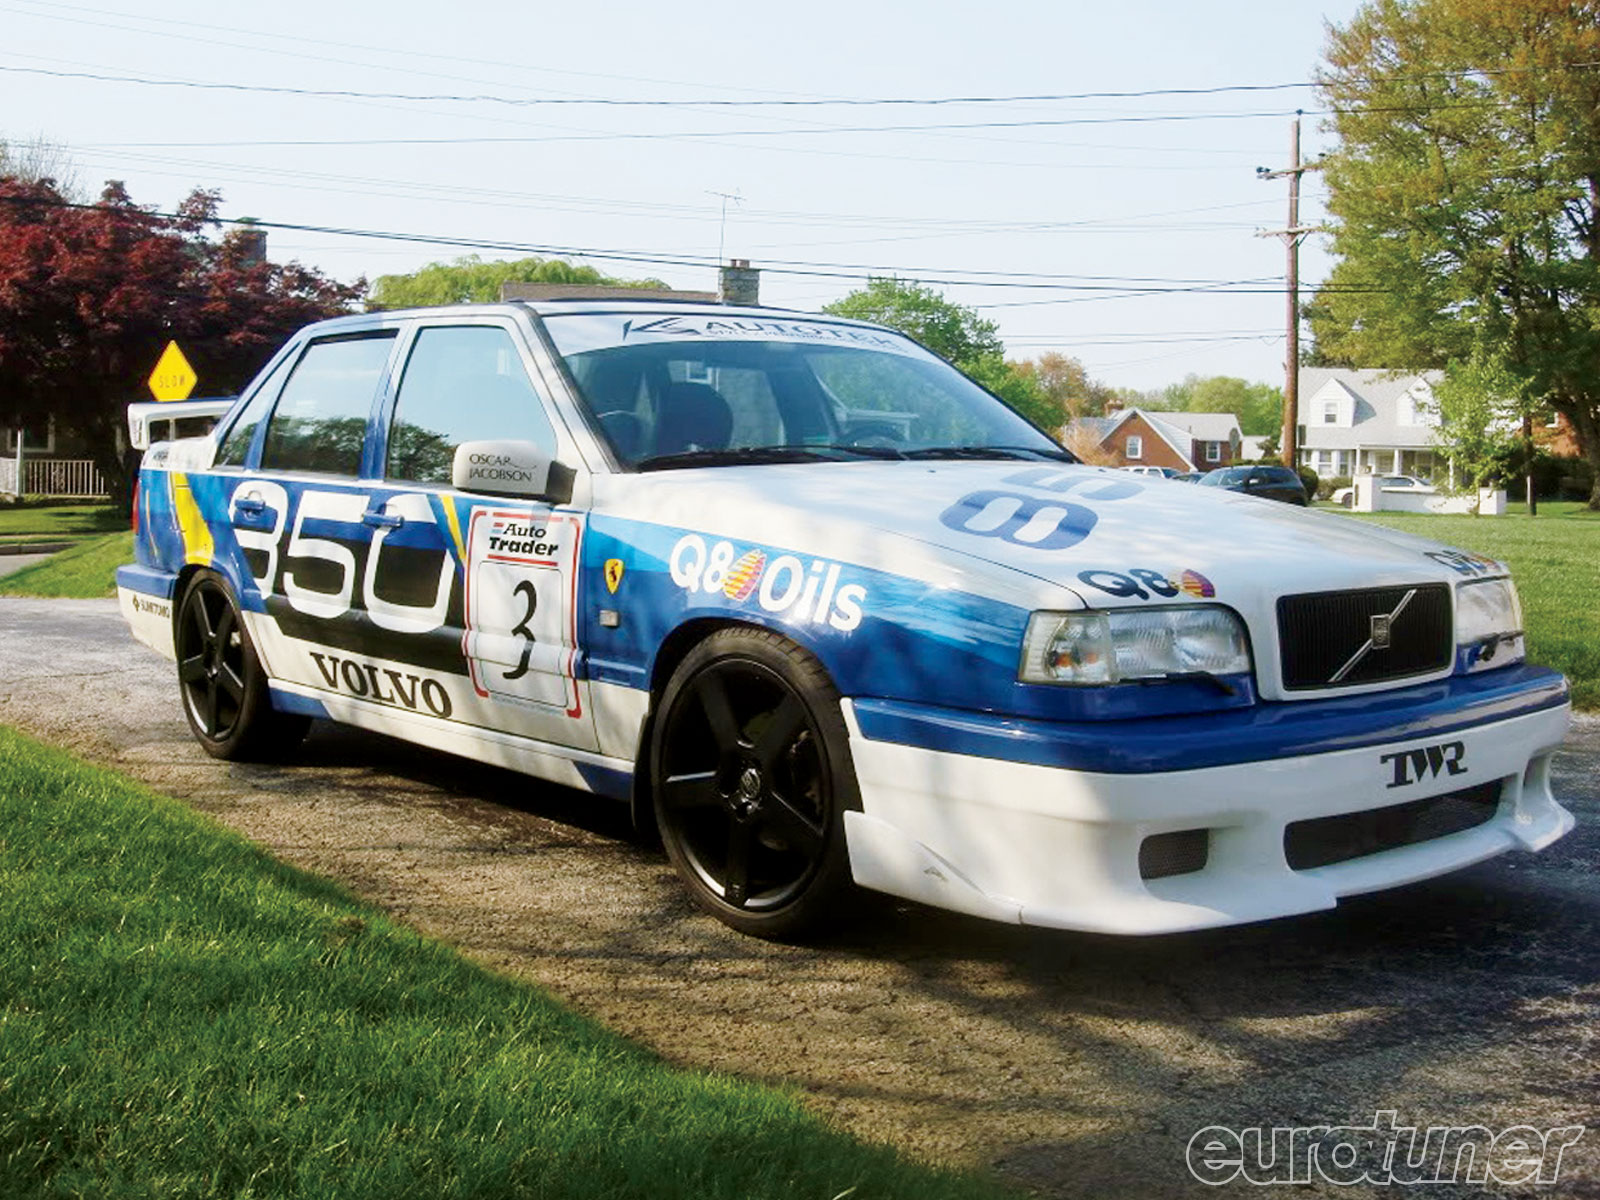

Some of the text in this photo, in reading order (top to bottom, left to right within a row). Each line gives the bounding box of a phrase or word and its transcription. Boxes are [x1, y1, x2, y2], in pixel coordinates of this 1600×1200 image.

[159, 375, 186, 389] SLOW
[469, 453, 517, 468] OSCAR
[469, 467, 533, 482] JACOBSON
[502, 523, 547, 539] Auto
[488, 537, 559, 556] Trader
[669, 534, 868, 632] Q8 Oils
[1077, 568, 1179, 600] Q8
[502, 580, 538, 680] 3
[309, 651, 453, 719] VOLVO
[1380, 740, 1469, 790] TWR
